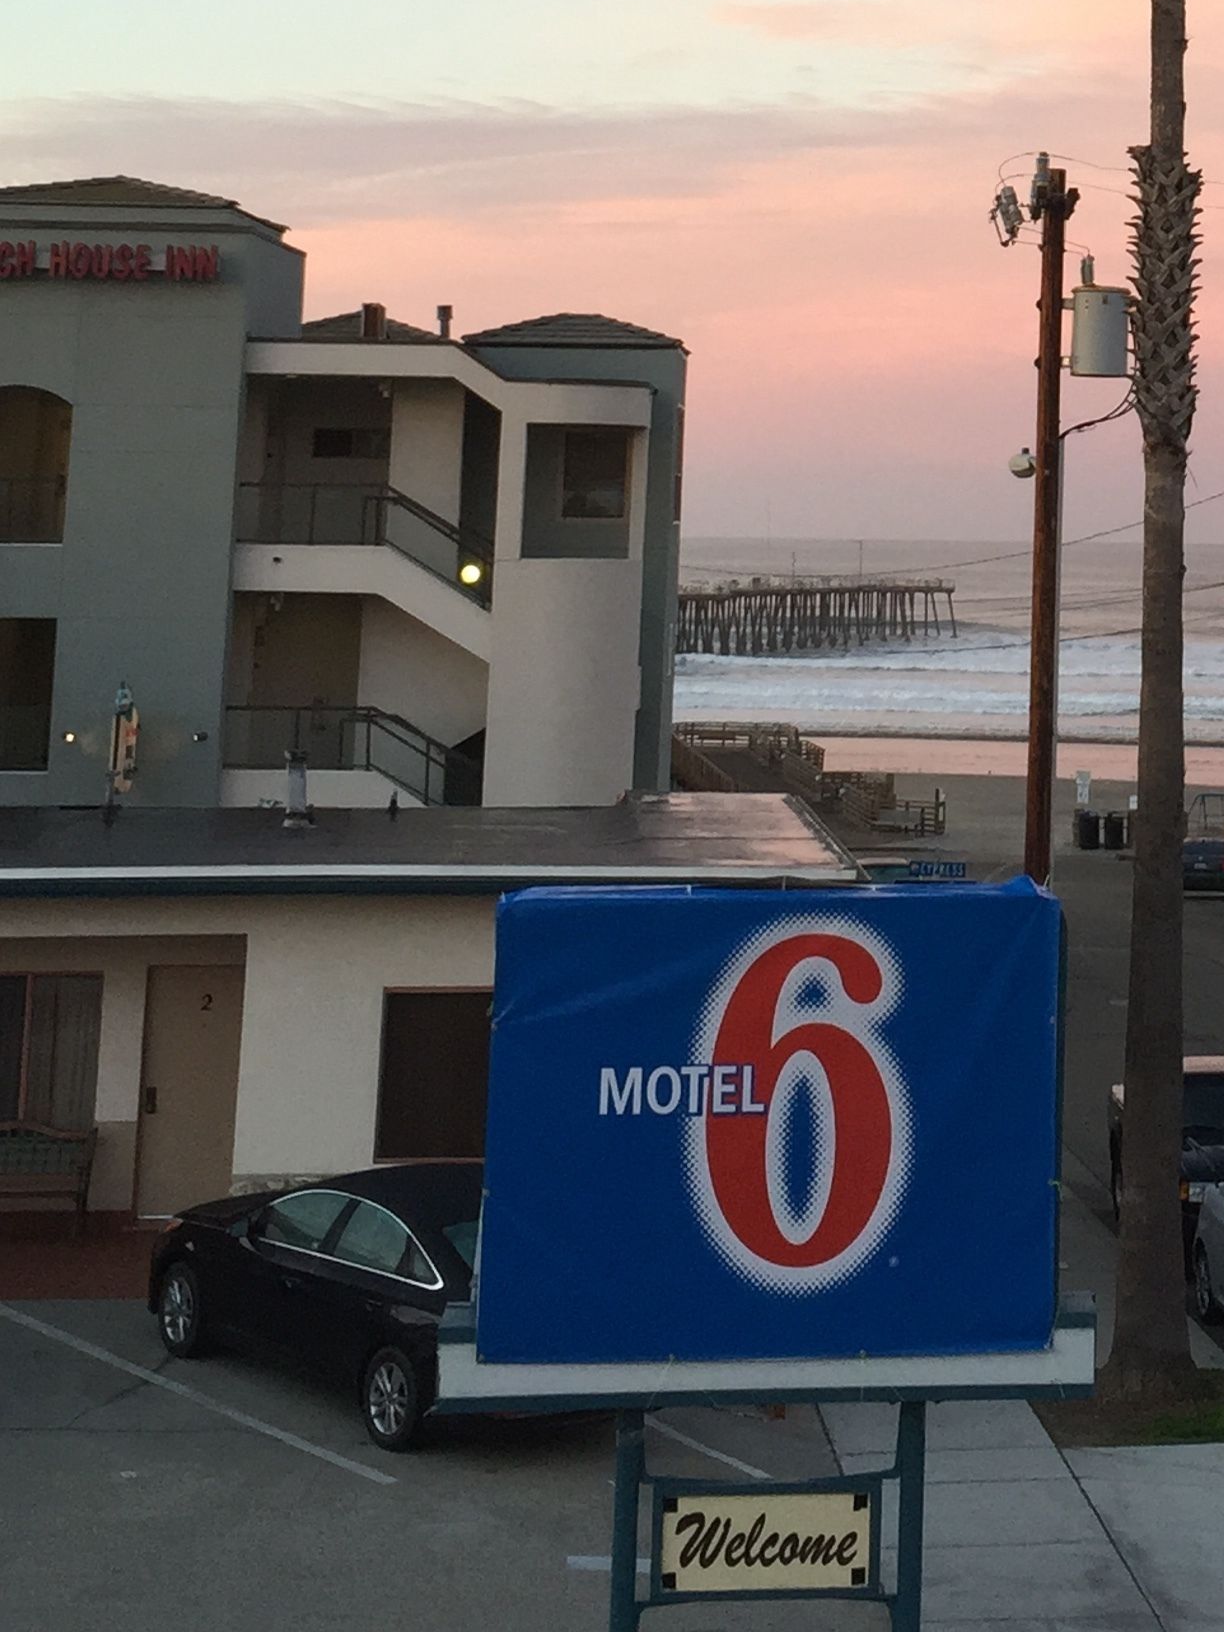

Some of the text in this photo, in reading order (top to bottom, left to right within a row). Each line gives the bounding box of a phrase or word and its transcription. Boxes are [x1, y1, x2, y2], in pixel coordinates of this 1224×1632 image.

[50, 240, 150, 279] HOUSE
[166, 244, 219, 280] INN
[200, 993, 213, 1011] 2
[599, 931, 894, 1270] MOTEL 6
[675, 1512, 858, 1569] Welcome
